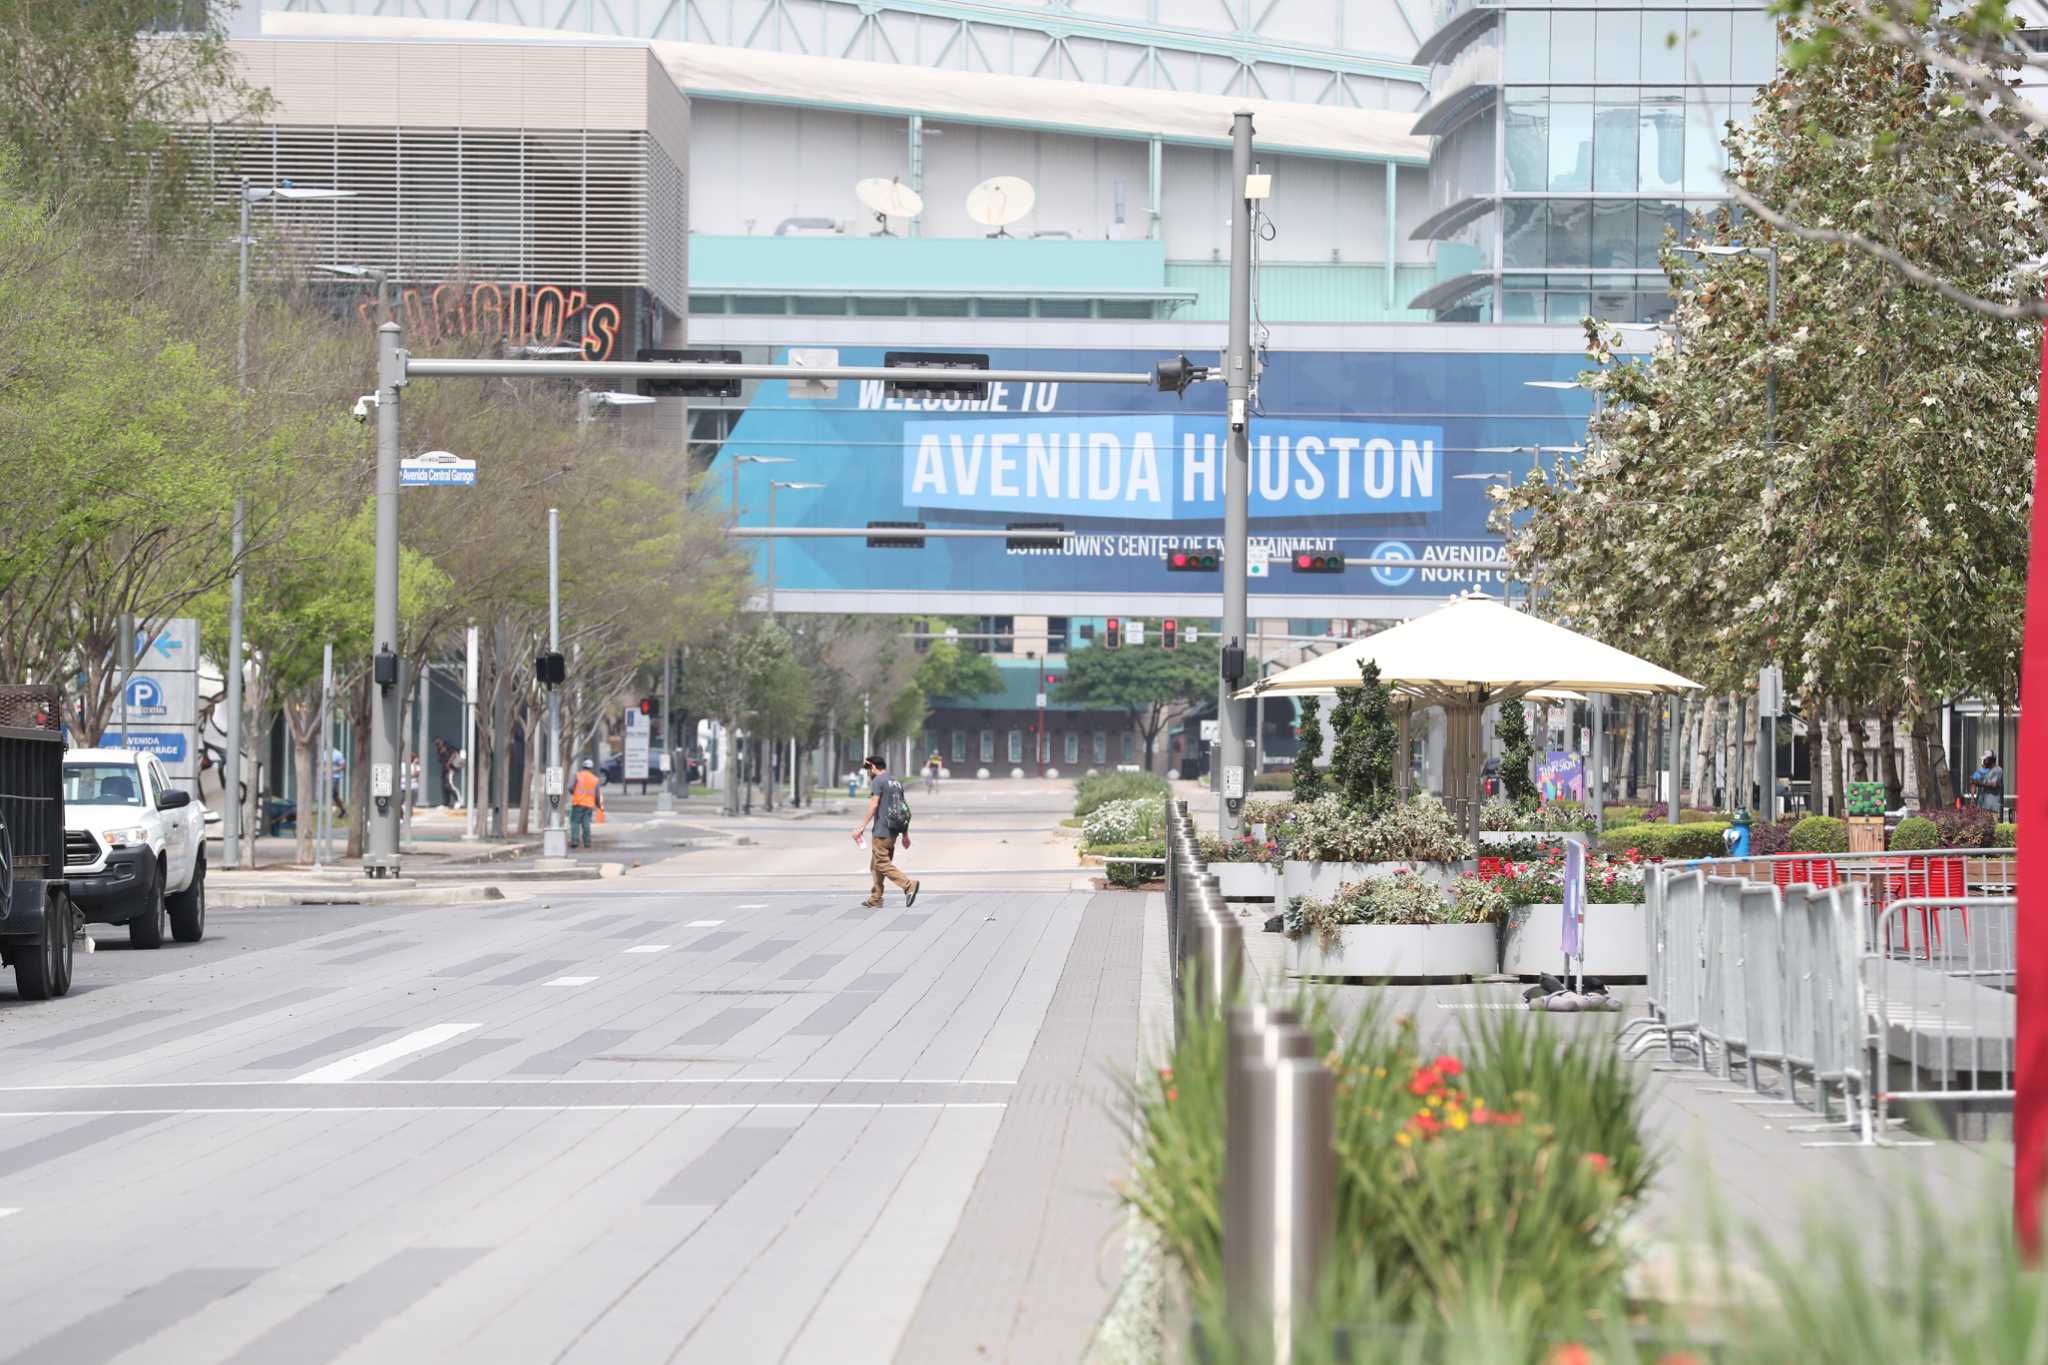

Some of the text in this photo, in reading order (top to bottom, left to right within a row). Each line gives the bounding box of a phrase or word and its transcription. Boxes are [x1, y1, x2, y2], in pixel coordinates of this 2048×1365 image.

[911, 432, 1433, 502] AVENIDA HUSTON
[1118, 535, 1179, 557] CENTER
[1207, 536, 1337, 558] ENTAINMENT
[1422, 545, 1507, 563] AVENIDA
[135, 684, 153, 706] P
[126, 737, 160, 745] VENIDA
